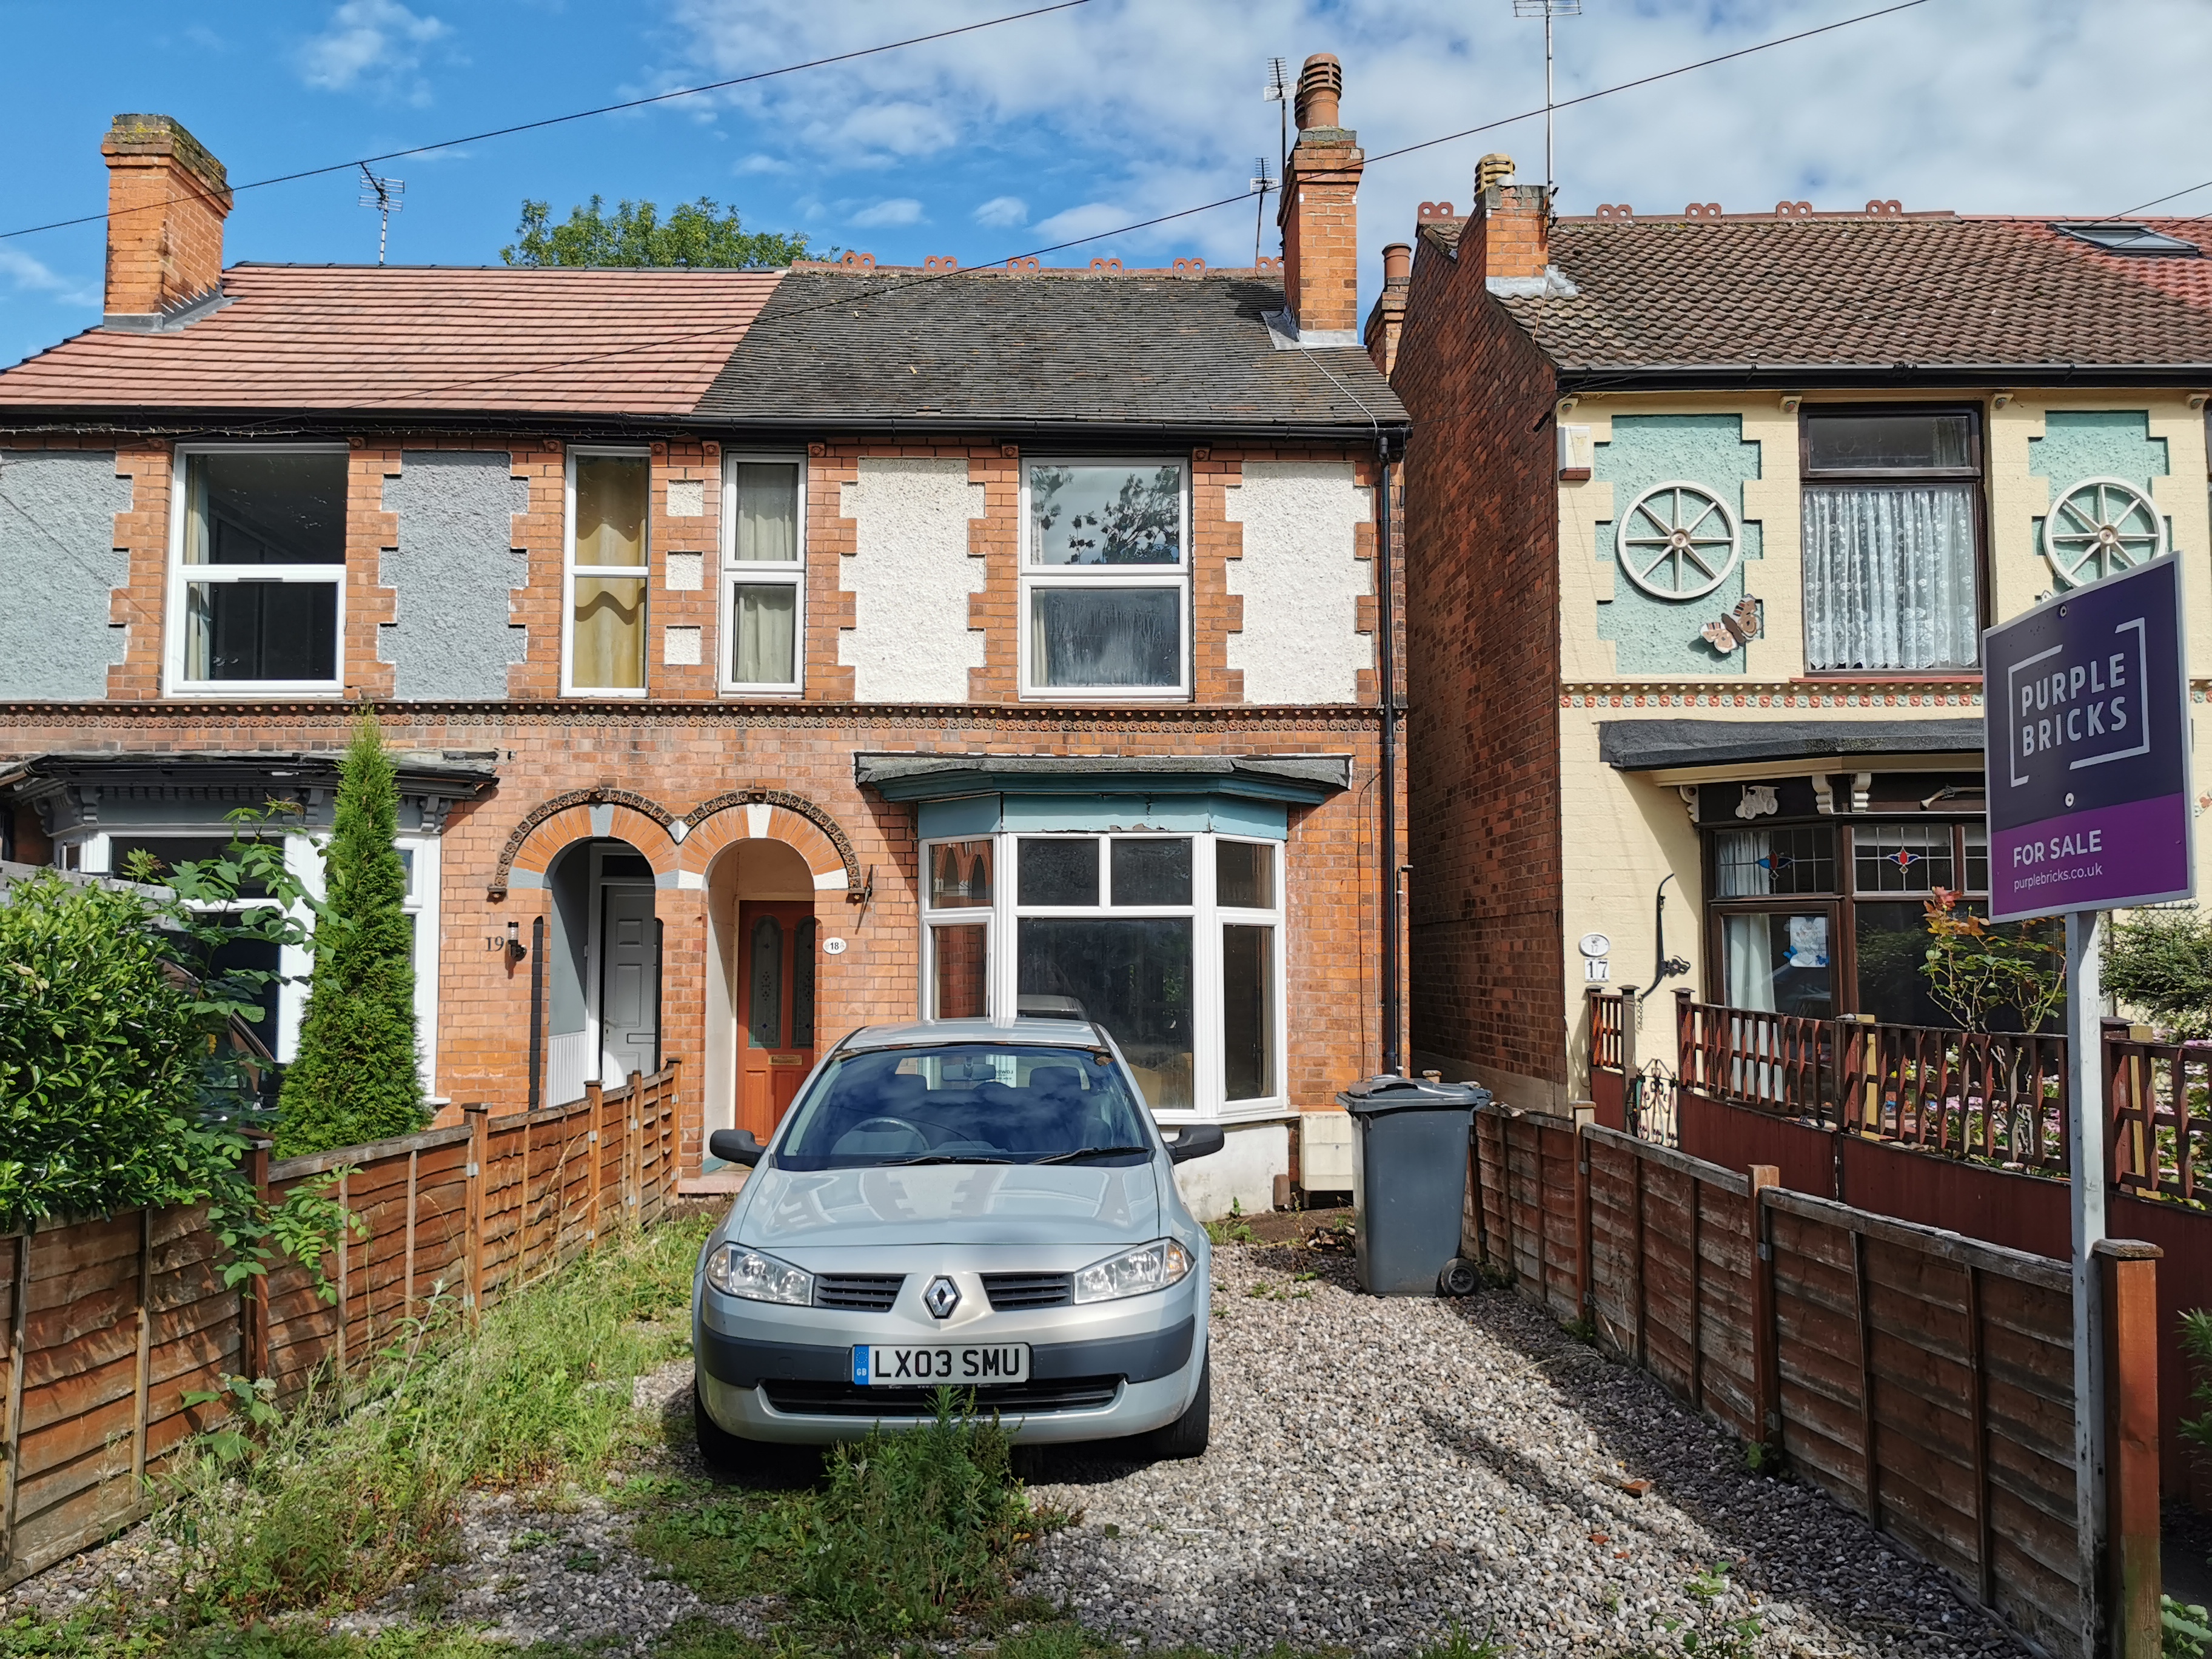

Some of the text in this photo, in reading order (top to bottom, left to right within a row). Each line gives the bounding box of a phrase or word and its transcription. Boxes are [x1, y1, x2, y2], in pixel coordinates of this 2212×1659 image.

[2022, 653, 2126, 717] PURPLE
[2022, 696, 2127, 757] BRICKS
[2013, 830, 2102, 868] FOR SALE
[2014, 862, 2103, 893] purplebricks.co.uk
[486, 936, 504, 952] 19
[830, 942, 839, 950] 18
[1587, 961, 1607, 978] 17
[856, 1367, 867, 1376] GB
[875, 1348, 1019, 1378] LX03 SMU
